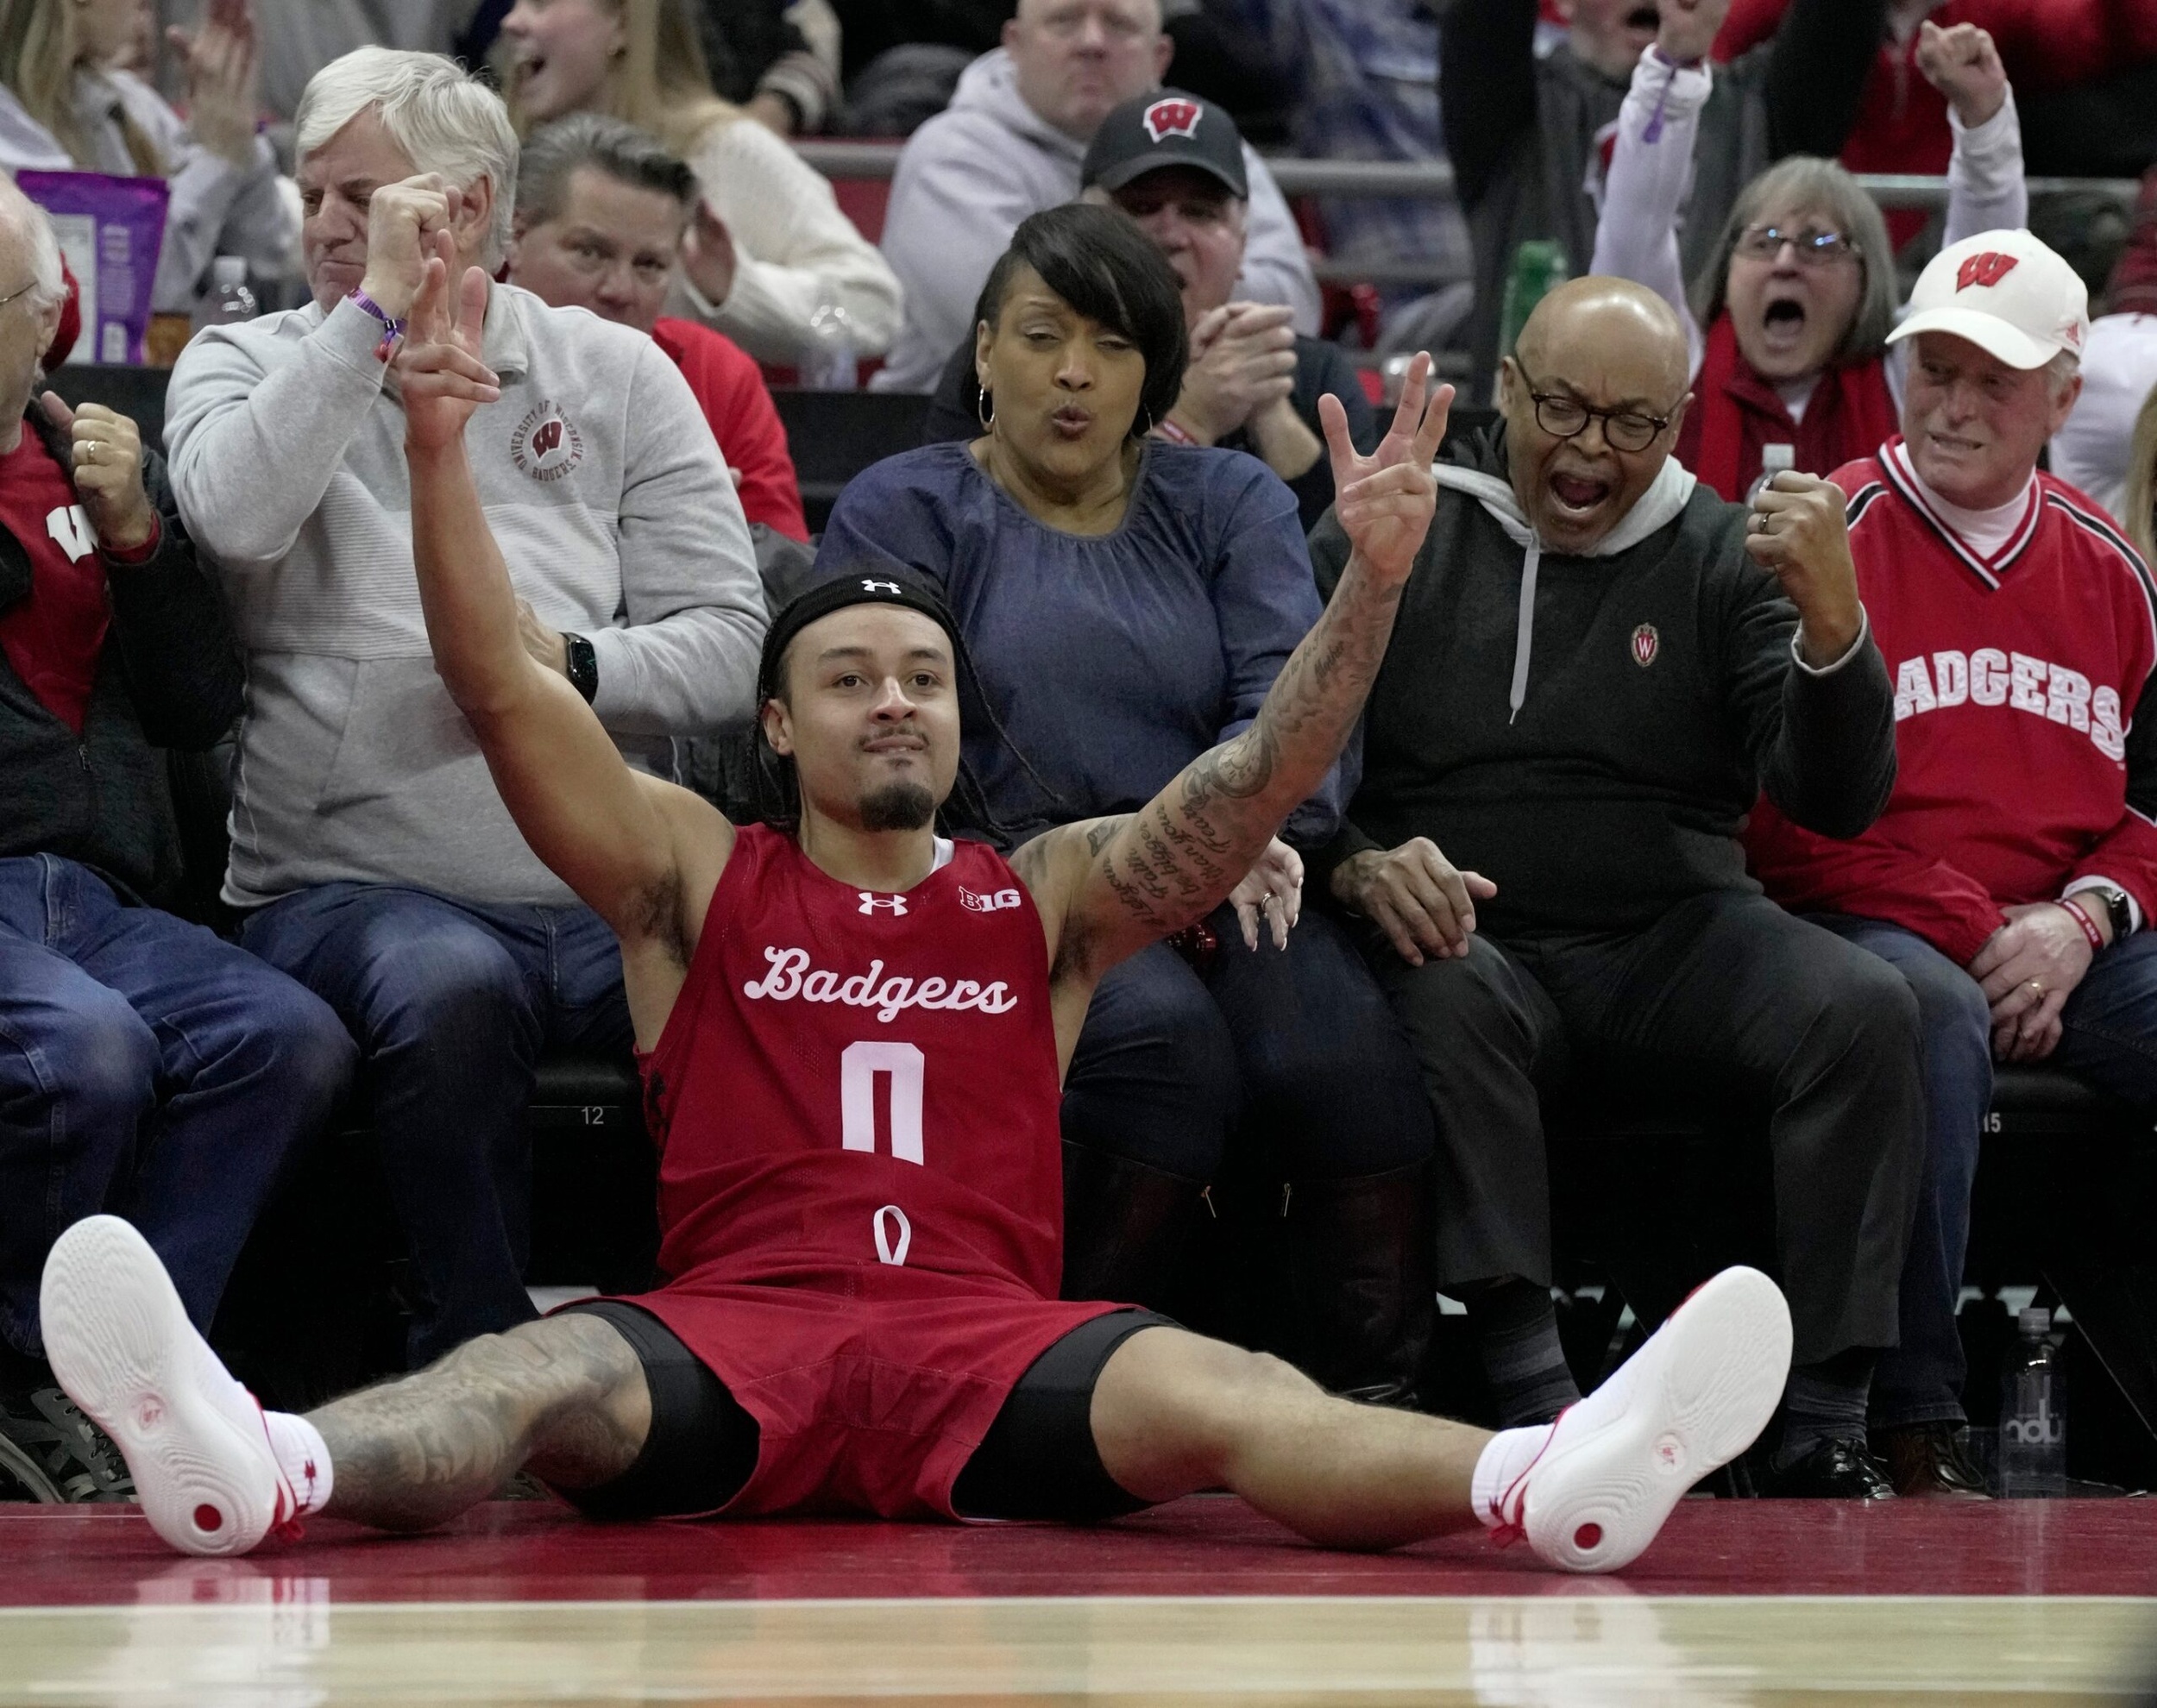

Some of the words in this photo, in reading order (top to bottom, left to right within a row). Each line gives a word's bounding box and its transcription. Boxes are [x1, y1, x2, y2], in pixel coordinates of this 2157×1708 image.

[1144, 98, 1201, 141] W
[1956, 251, 2019, 293] W
[511, 409, 537, 470] UNIVERSITY
[538, 399, 550, 414] OF
[555, 403, 583, 461] WISCONSIN
[531, 421, 563, 462] W
[531, 459, 576, 481] BADGERS
[1638, 637, 1654, 658] W
[1894, 648, 2125, 761] ADGERS
[744, 945, 1017, 1023] Badgers
[581, 1107, 604, 1125] 12
[841, 1040, 925, 1166] 0
[1984, 1112, 2001, 1133] 15
